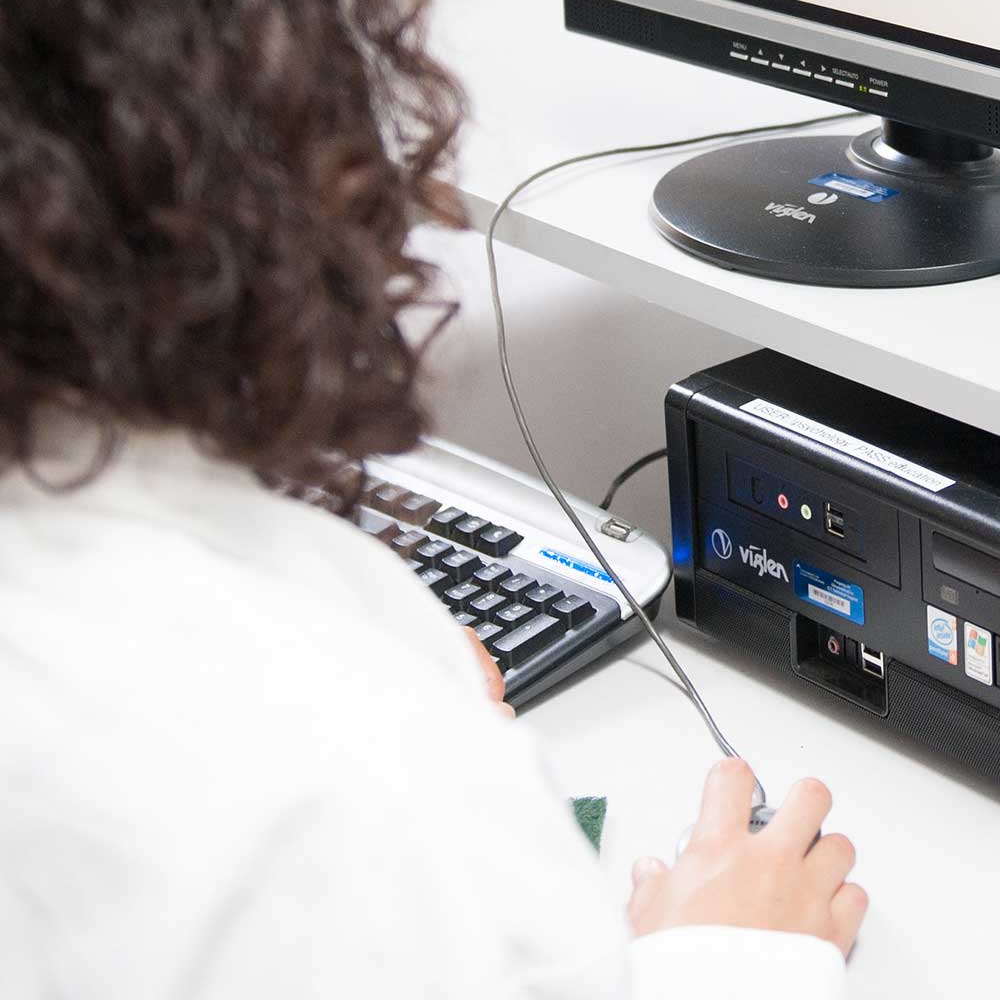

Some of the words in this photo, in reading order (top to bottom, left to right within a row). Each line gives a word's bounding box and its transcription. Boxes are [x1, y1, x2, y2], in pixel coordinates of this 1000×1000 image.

[869, 77, 889, 88] POWER
[752, 401, 789, 422] USER
[856, 444, 889, 465] PASS
